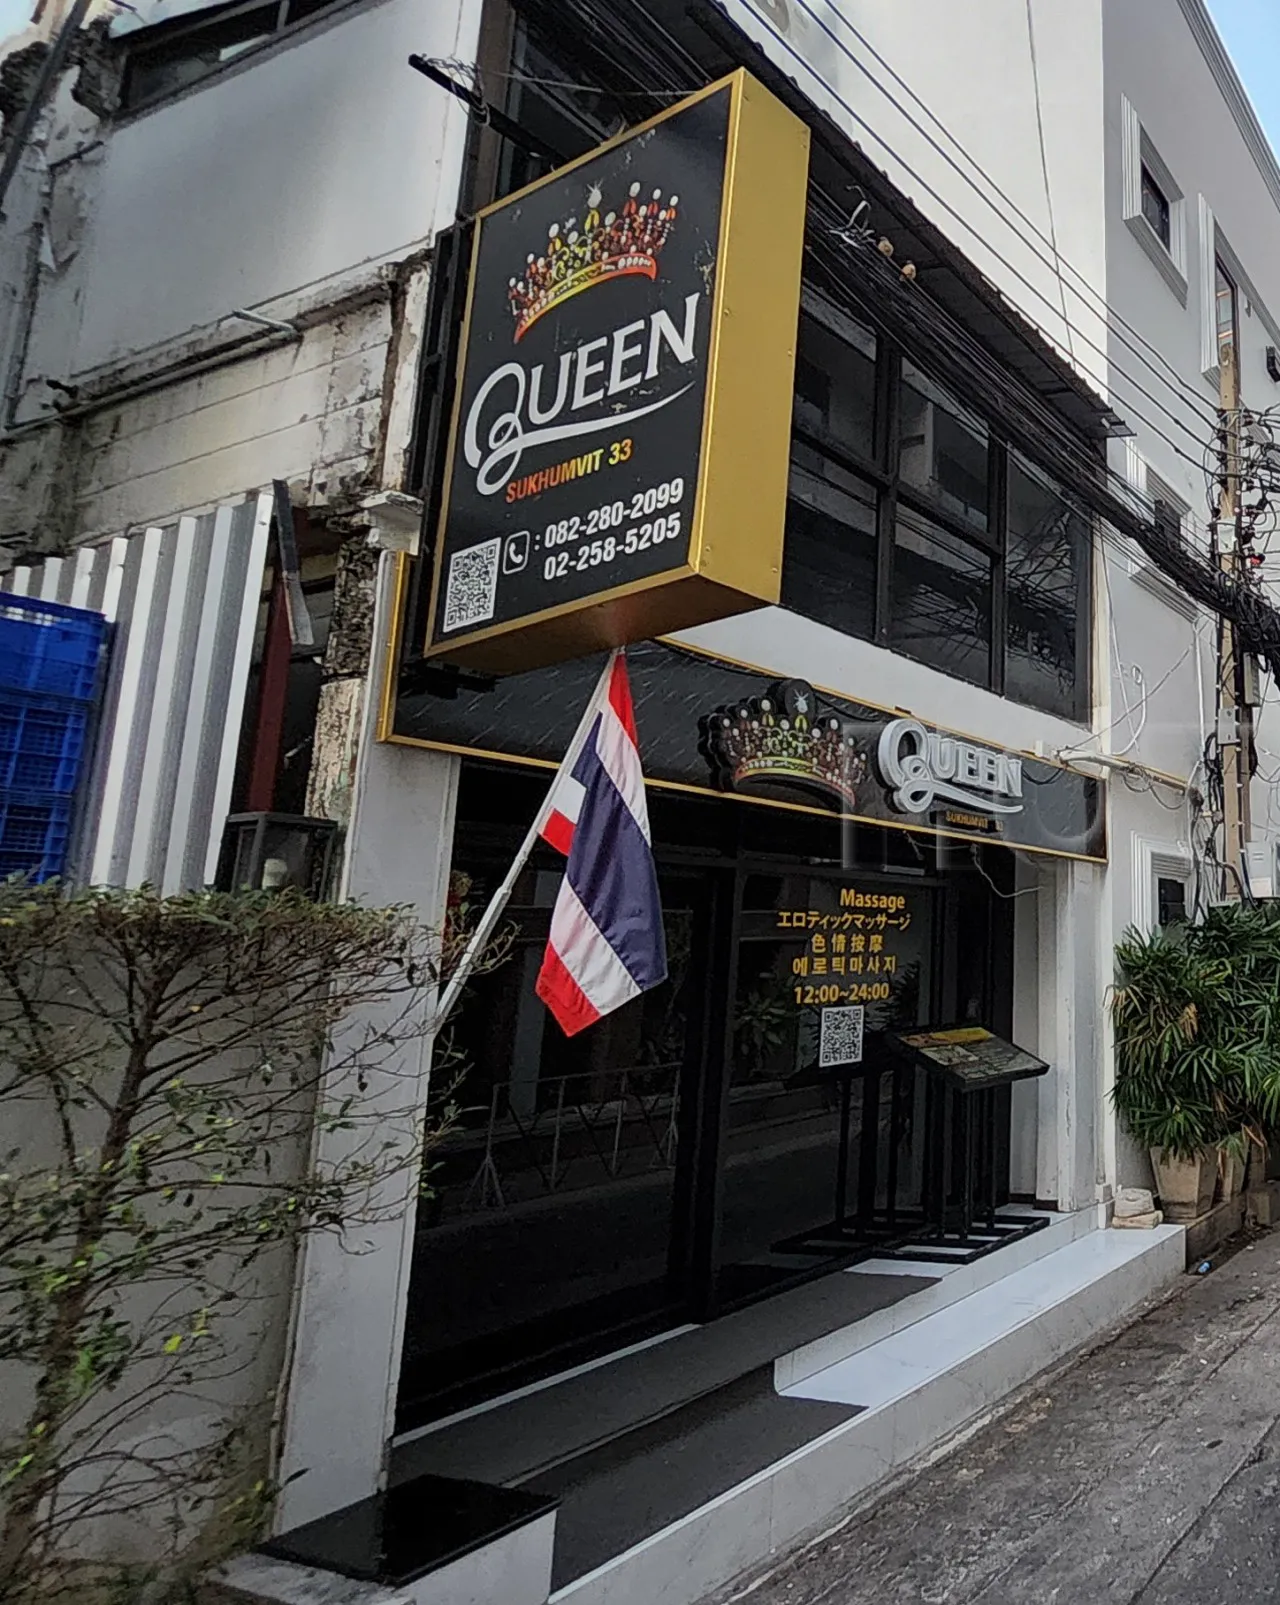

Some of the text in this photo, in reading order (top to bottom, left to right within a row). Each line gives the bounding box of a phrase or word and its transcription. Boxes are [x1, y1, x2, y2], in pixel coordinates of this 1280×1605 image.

[464, 293, 700, 495] QUEEN
[506, 438, 633, 503] SUKHUMVIT 33
[543, 478, 684, 549] 082-280-2099
[543, 512, 681, 580] 02-258-5205
[878, 718, 1024, 813] QUEEN
[777, 911, 911, 931] エロティックマッサージ
[840, 888, 905, 912] Massage
[794, 982, 889, 1004] 12:00~24:00
